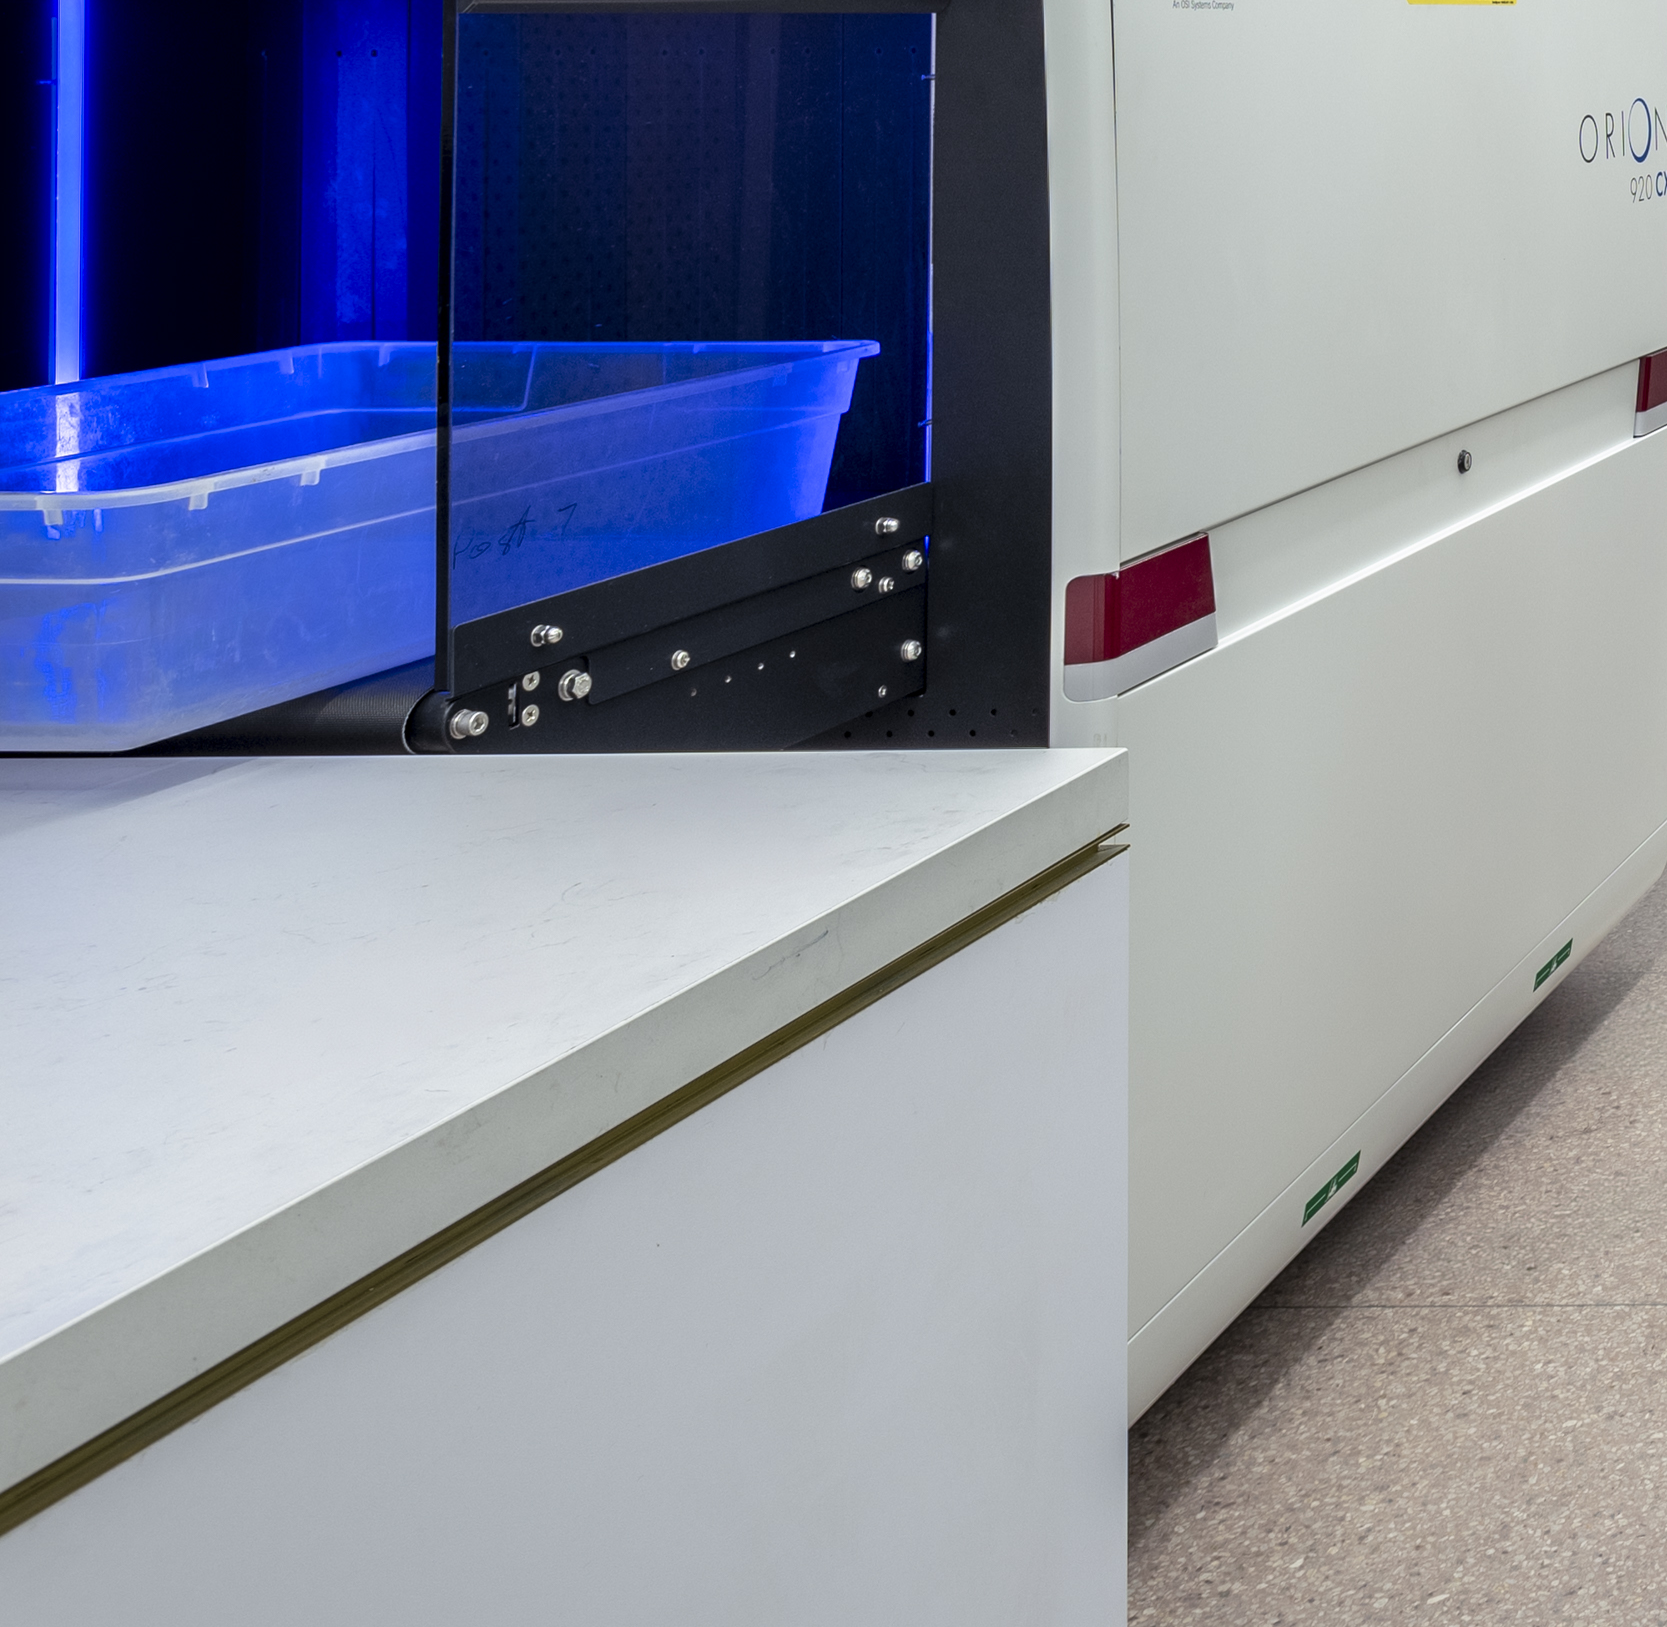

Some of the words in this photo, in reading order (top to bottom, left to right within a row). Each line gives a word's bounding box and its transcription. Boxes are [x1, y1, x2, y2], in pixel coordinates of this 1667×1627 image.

[1172, 0, 1180, 9] An
[1181, 0, 1190, 9] OSI
[1191, 0, 1211, 11] Systems
[1212, 0, 1234, 11] Company
[1630, 174, 1653, 203] 920
